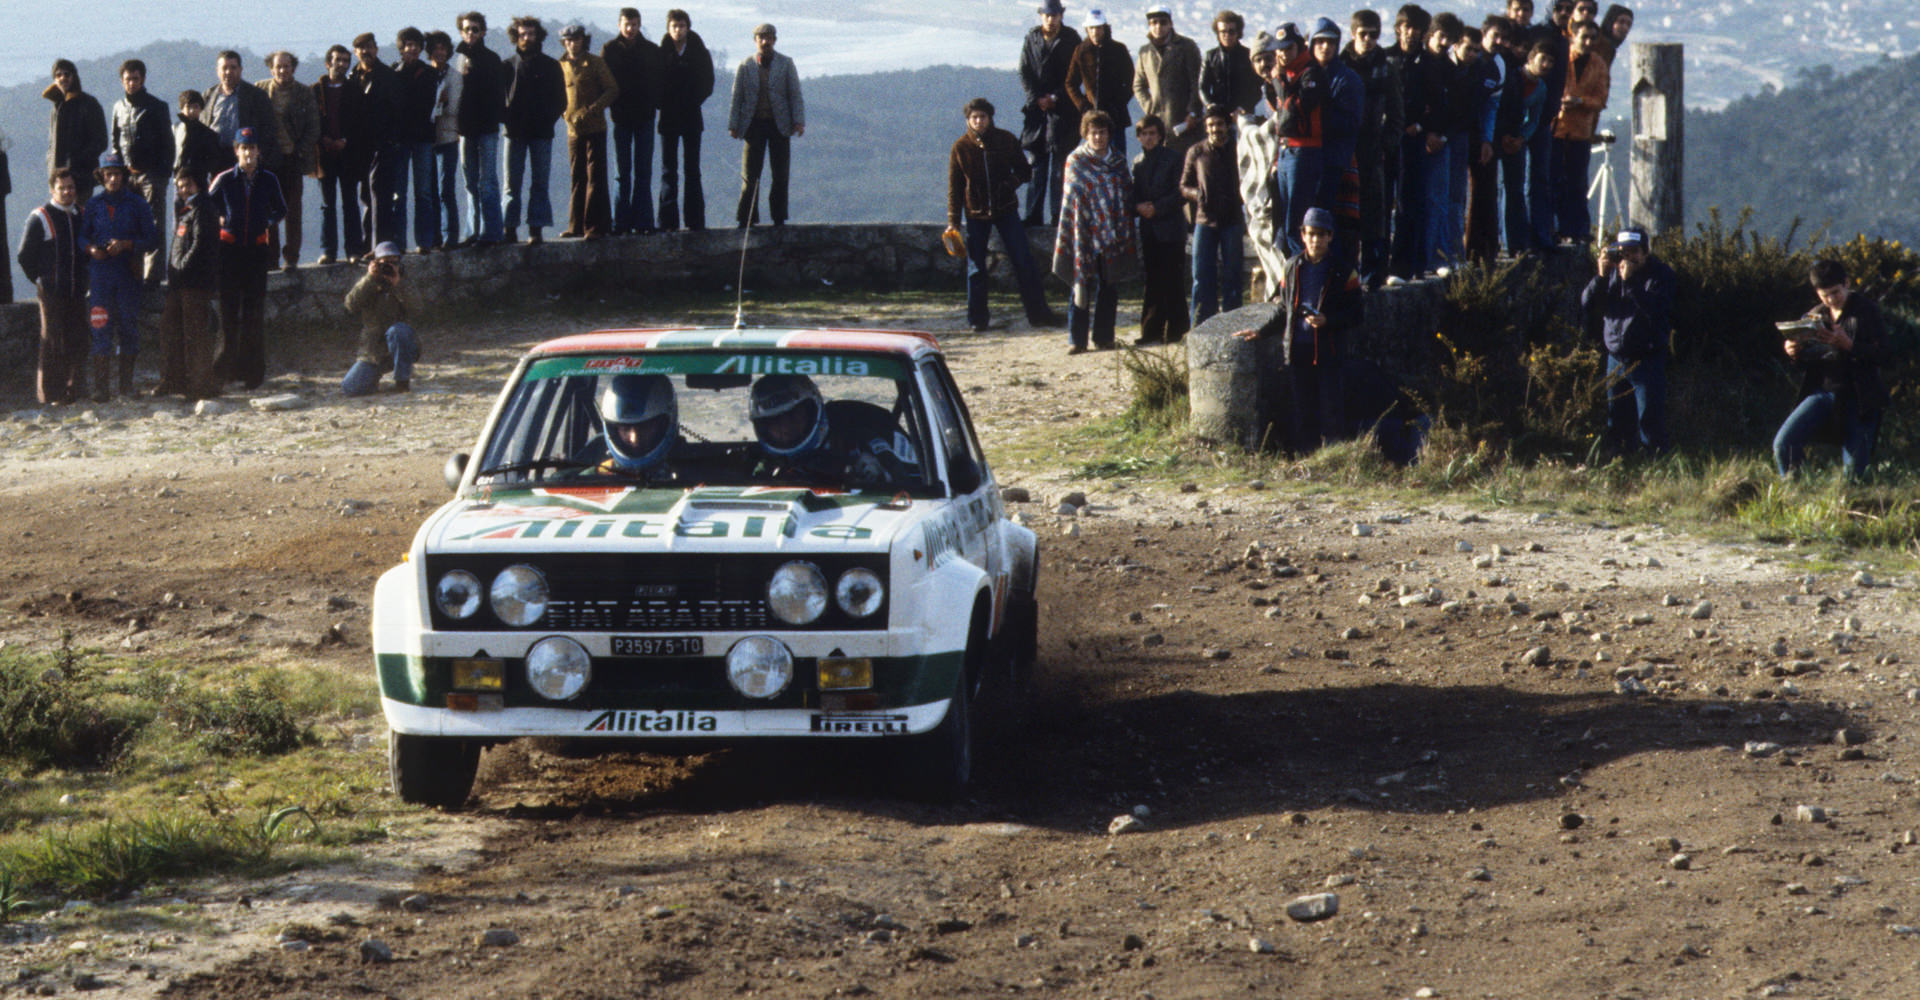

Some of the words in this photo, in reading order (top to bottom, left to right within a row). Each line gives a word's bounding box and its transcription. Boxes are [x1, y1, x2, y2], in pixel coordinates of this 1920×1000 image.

[713, 355, 870, 375] Alitalia
[449, 519, 873, 541] Alitalia
[626, 600, 766, 627] ABARTH
[584, 711, 717, 732] Alitalia
[810, 714, 910, 733] PIRELLI
